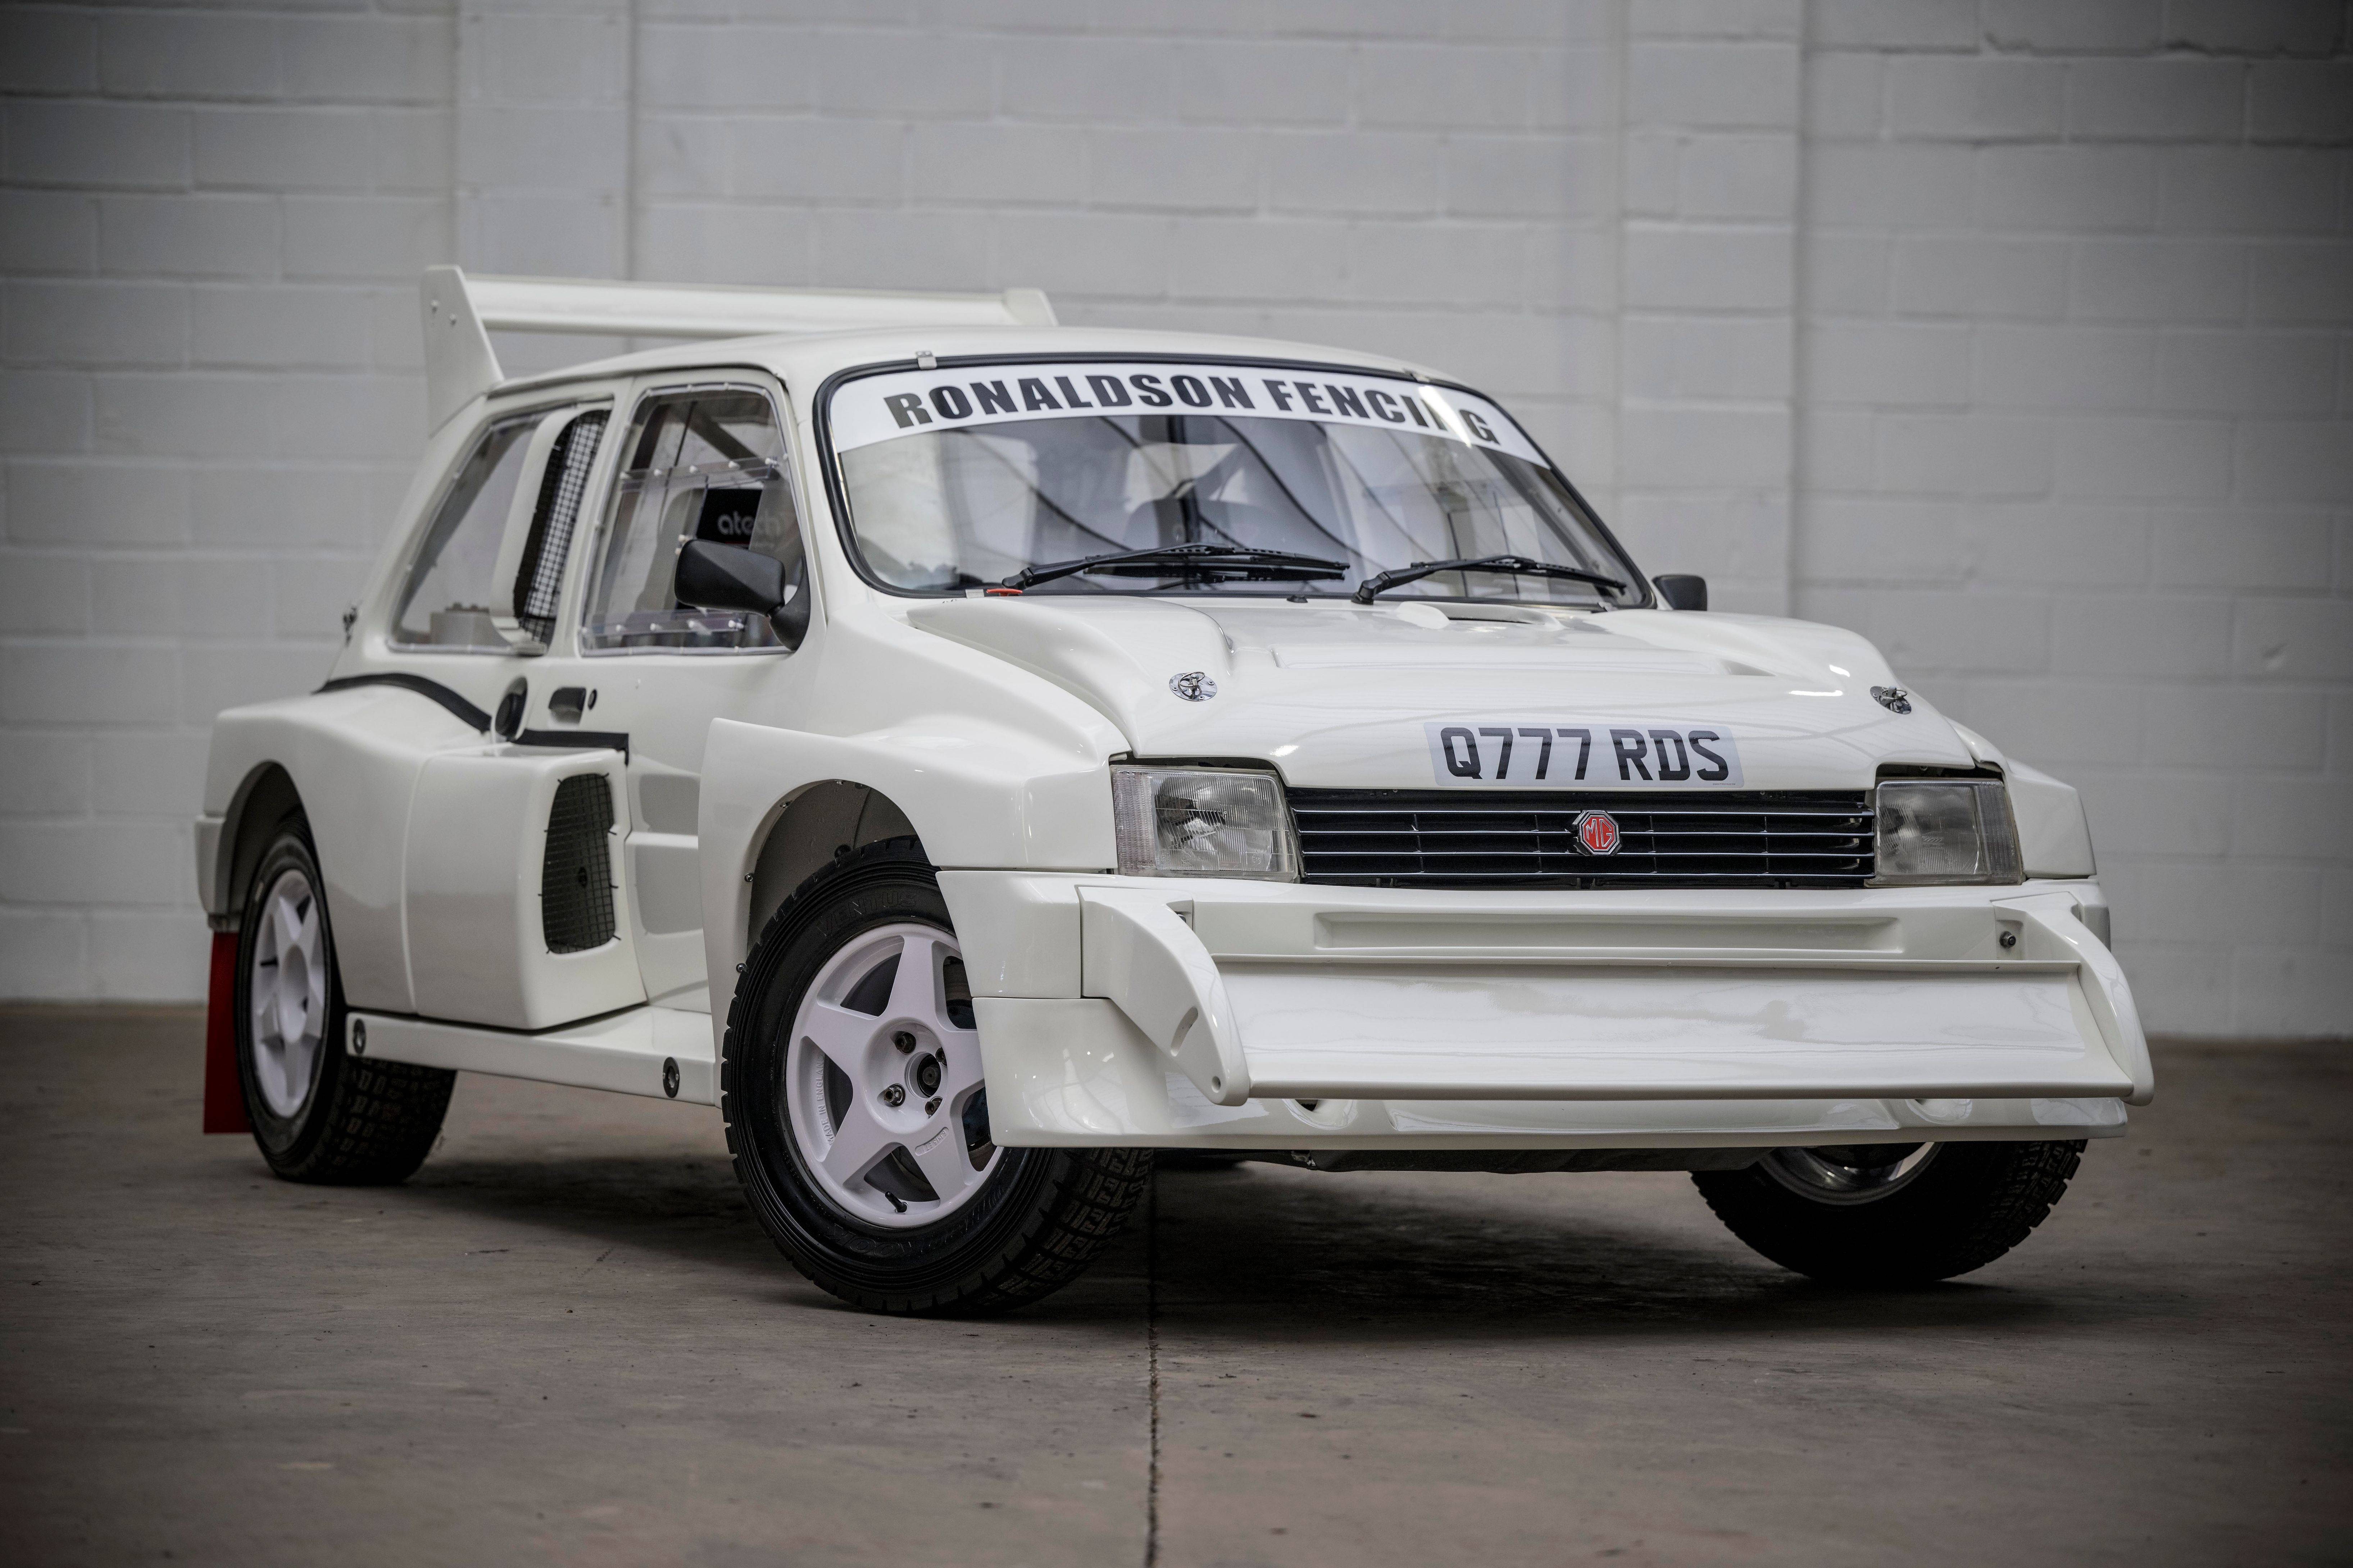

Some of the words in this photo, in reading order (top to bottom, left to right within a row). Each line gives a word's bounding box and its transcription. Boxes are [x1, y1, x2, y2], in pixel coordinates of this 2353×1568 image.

[883, 374, 1256, 428] RONALDSON
[1440, 727, 1591, 779] Q777
[1609, 729, 1729, 781] RDS
[1585, 819, 1613, 848] MG
[815, 891, 917, 938] VENTUS
[816, 1054, 825, 1101] ENGLAND
[818, 1104, 827, 1115] IN
[822, 1118, 836, 1145] MADE
